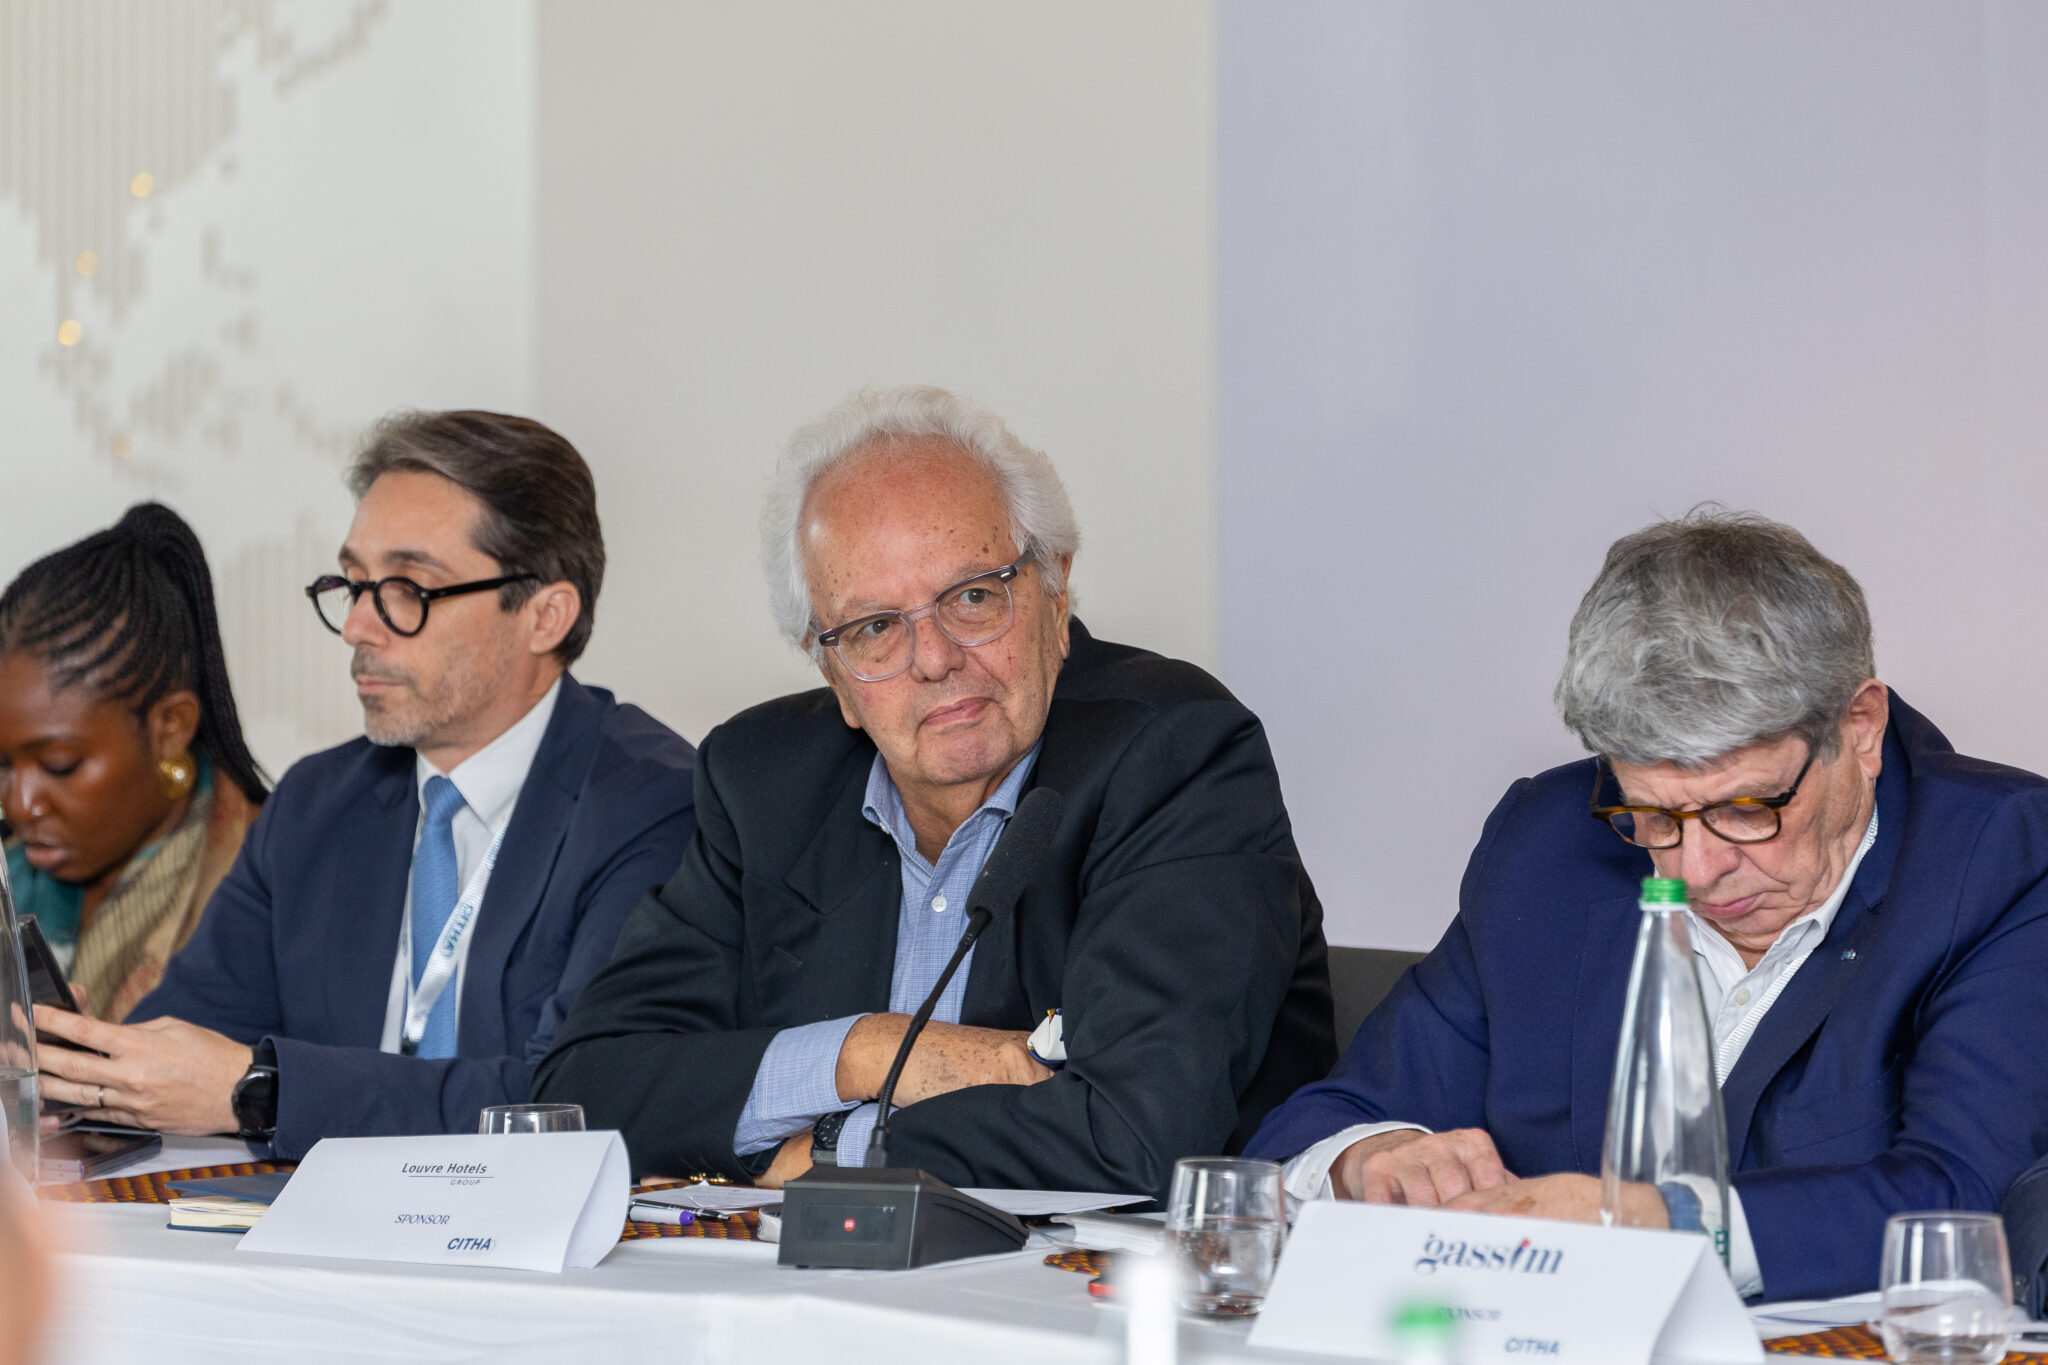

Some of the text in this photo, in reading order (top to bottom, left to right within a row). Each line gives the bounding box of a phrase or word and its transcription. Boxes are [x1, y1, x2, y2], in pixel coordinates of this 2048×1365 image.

[401, 1162, 488, 1174] Louvre Hotels
[394, 1214, 450, 1225] SPONSOR
[447, 1237, 492, 1251] CITHA
[1414, 1233, 1564, 1276] gassim
[1504, 1337, 1560, 1356] CITHA
